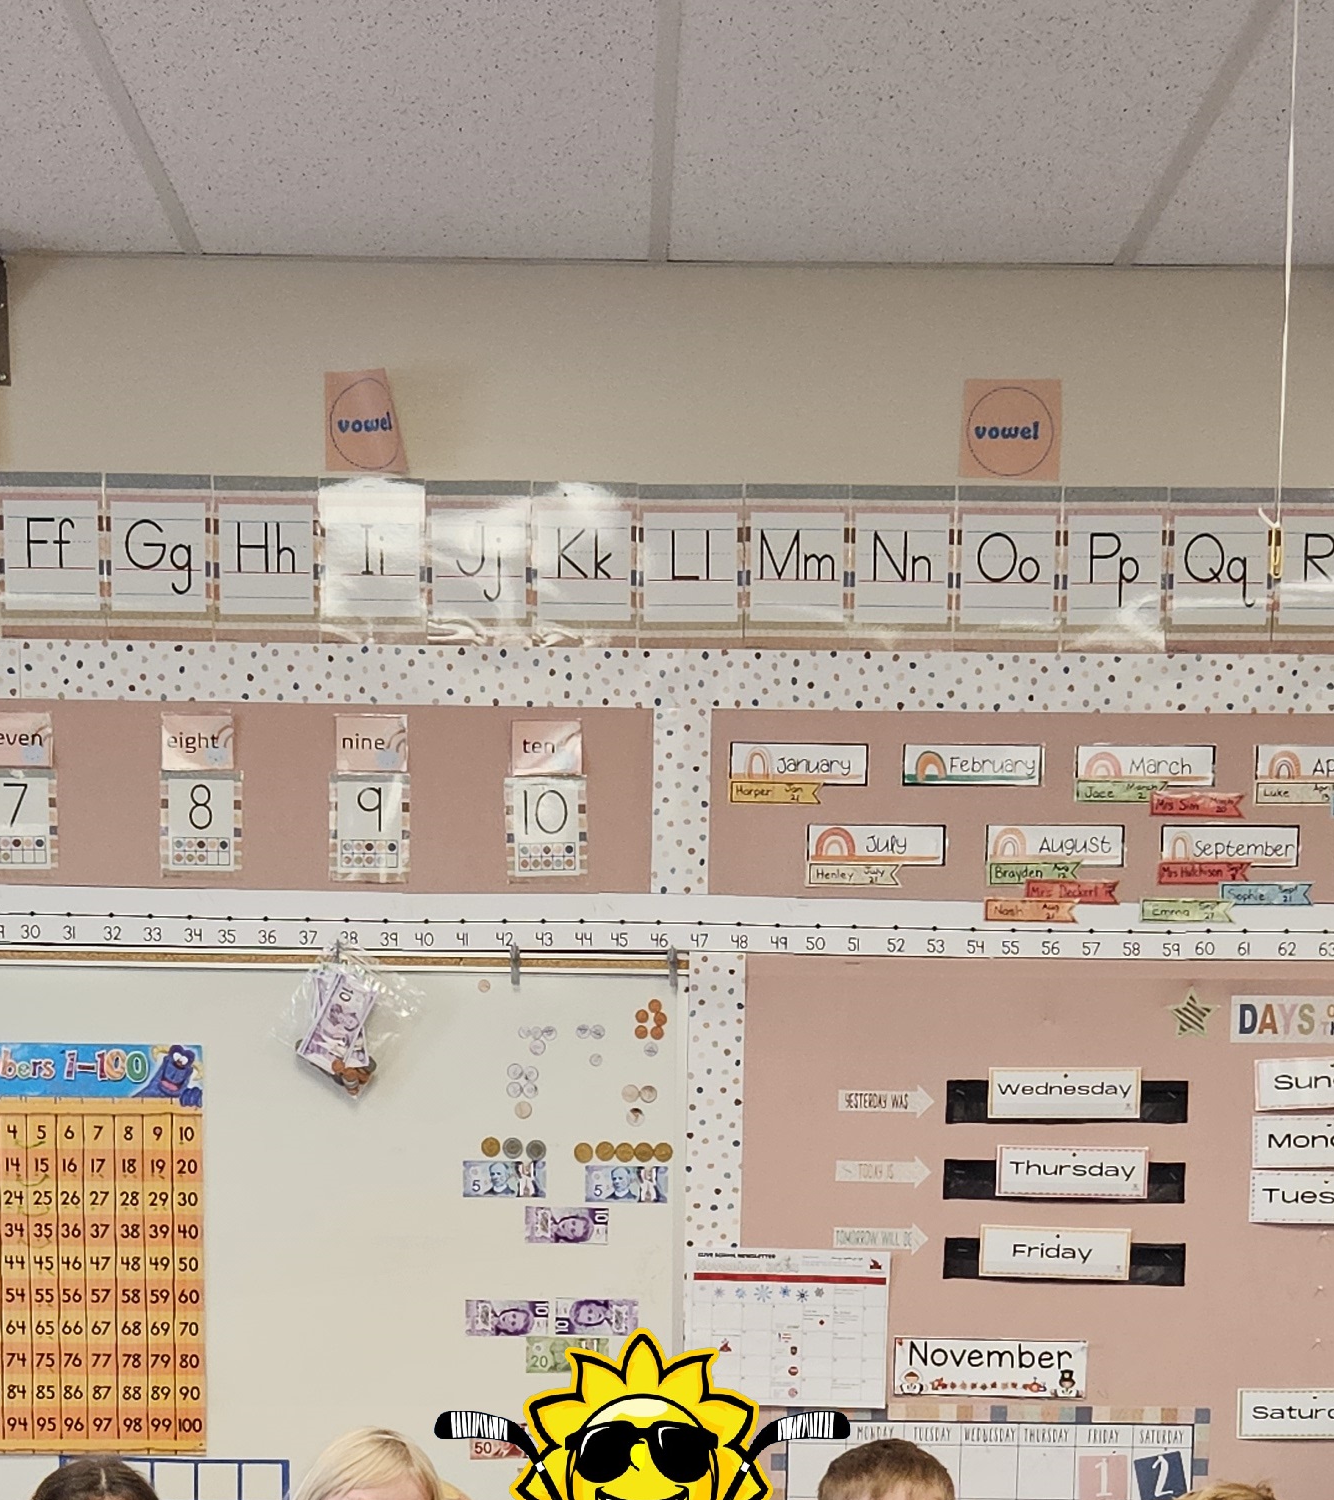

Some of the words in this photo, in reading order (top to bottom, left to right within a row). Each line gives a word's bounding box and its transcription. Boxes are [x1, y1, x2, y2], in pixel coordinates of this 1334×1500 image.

[337, 414, 392, 435] vowel
[974, 421, 1039, 440] vowel
[27, 518, 75, 569] Ff
[125, 520, 193, 595] Gg
[236, 522, 296, 574] Hh
[360, 525, 385, 575] Ii
[456, 526, 501, 601] Jj
[557, 528, 612, 579] Kk
[670, 530, 711, 581] Ll
[759, 530, 836, 581] Mm
[873, 532, 932, 582] Nn
[977, 534, 1040, 584] Oo
[1090, 534, 1139, 608] Pp
[1185, 534, 1256, 607] Qq
[167, 732, 219, 753] eight
[341, 734, 385, 751] nine
[522, 738, 555, 754] ten
[777, 756, 851, 776] January
[950, 756, 1036, 776] February
[1130, 758, 1192, 775] March
[2, 783, 28, 828] 7
[189, 783, 212, 830] 8
[357, 787, 382, 832] 9
[523, 788, 568, 835] 10
[866, 835, 906, 855] July
[1039, 837, 1112, 856] August
[1194, 840, 1295, 862] September
[816, 869, 854, 882] Henley
[994, 867, 1043, 880] Brayden
[1239, 1003, 1316, 1036] DAYS
[64, 1048, 149, 1083] 1-100
[998, 1081, 1132, 1099] Wednesday
[1010, 1160, 1136, 1182] Thursday
[1012, 1243, 1093, 1264] Friday
[908, 1340, 1073, 1373] November
